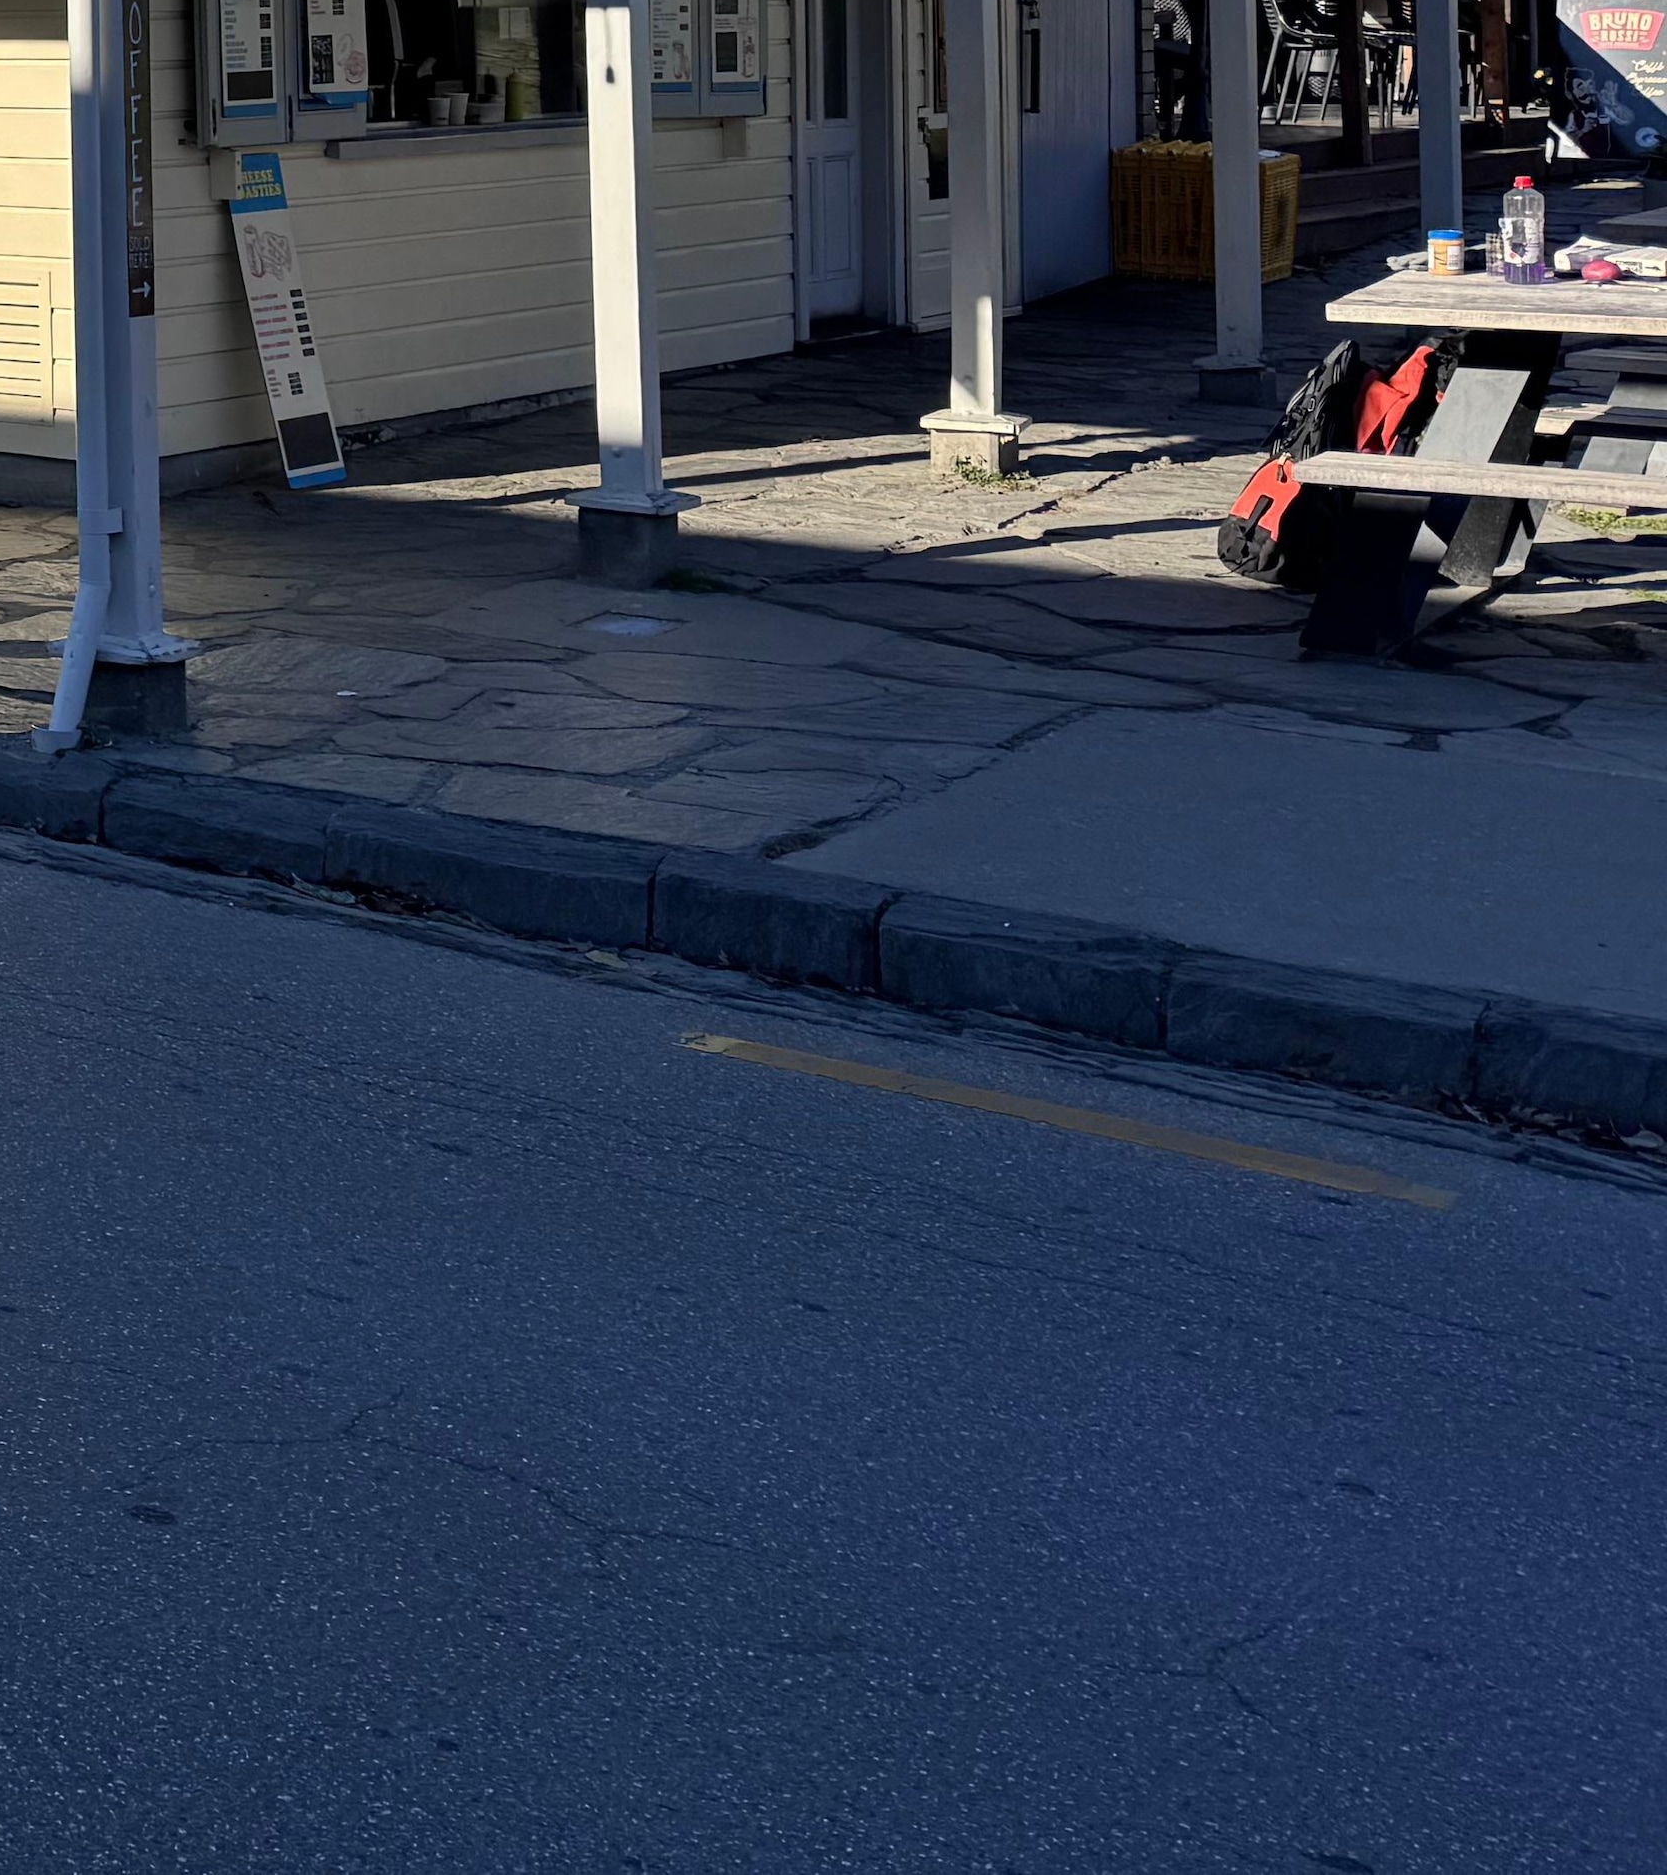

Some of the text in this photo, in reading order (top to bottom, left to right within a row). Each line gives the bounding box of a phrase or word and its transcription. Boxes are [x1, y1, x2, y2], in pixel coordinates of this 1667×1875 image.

[1588, 11, 1653, 31] BRUNO
[1600, 29, 1639, 42] ROSSI
[241, 168, 274, 185] HEESE
[128, 235, 151, 252] SOLD
